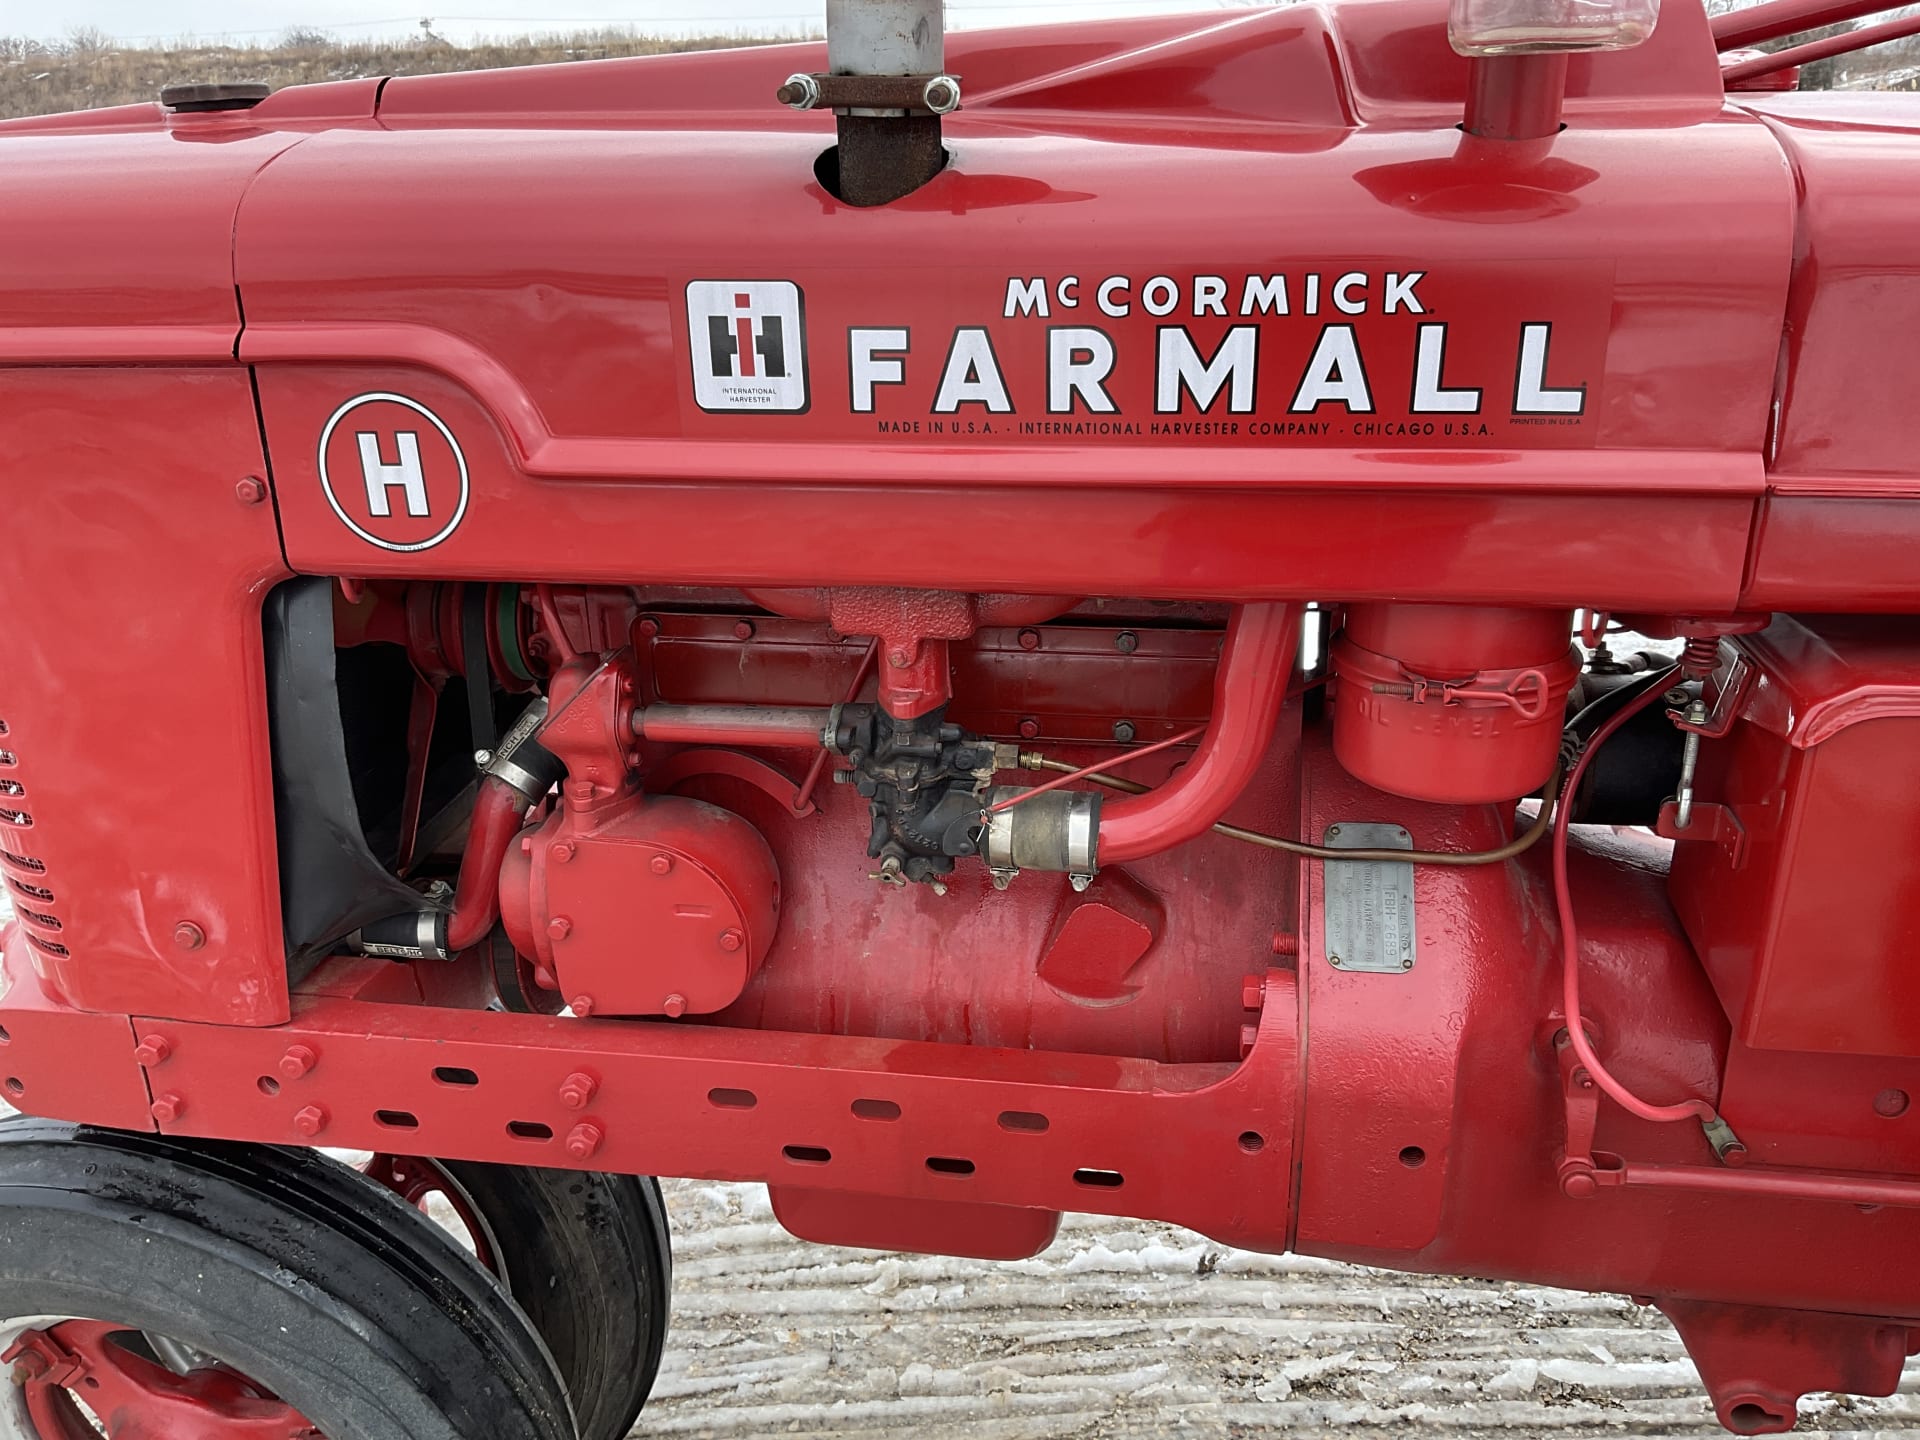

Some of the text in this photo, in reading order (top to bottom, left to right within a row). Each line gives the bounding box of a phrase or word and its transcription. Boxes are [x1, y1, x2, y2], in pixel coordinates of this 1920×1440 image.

[847, 321, 1586, 415] FARMALL
[722, 387, 777, 396] INTERNATIONAL
[729, 396, 771, 404] HARVESTER
[878, 421, 1495, 436] MADE IN U.S.A. INTERNATIONAL HARVESTER COMPANY CHICAGO U.S.A.
[1509, 418, 1546, 426] PRINTED
[355, 430, 431, 518] H
[1357, 697, 1391, 727] OIL
